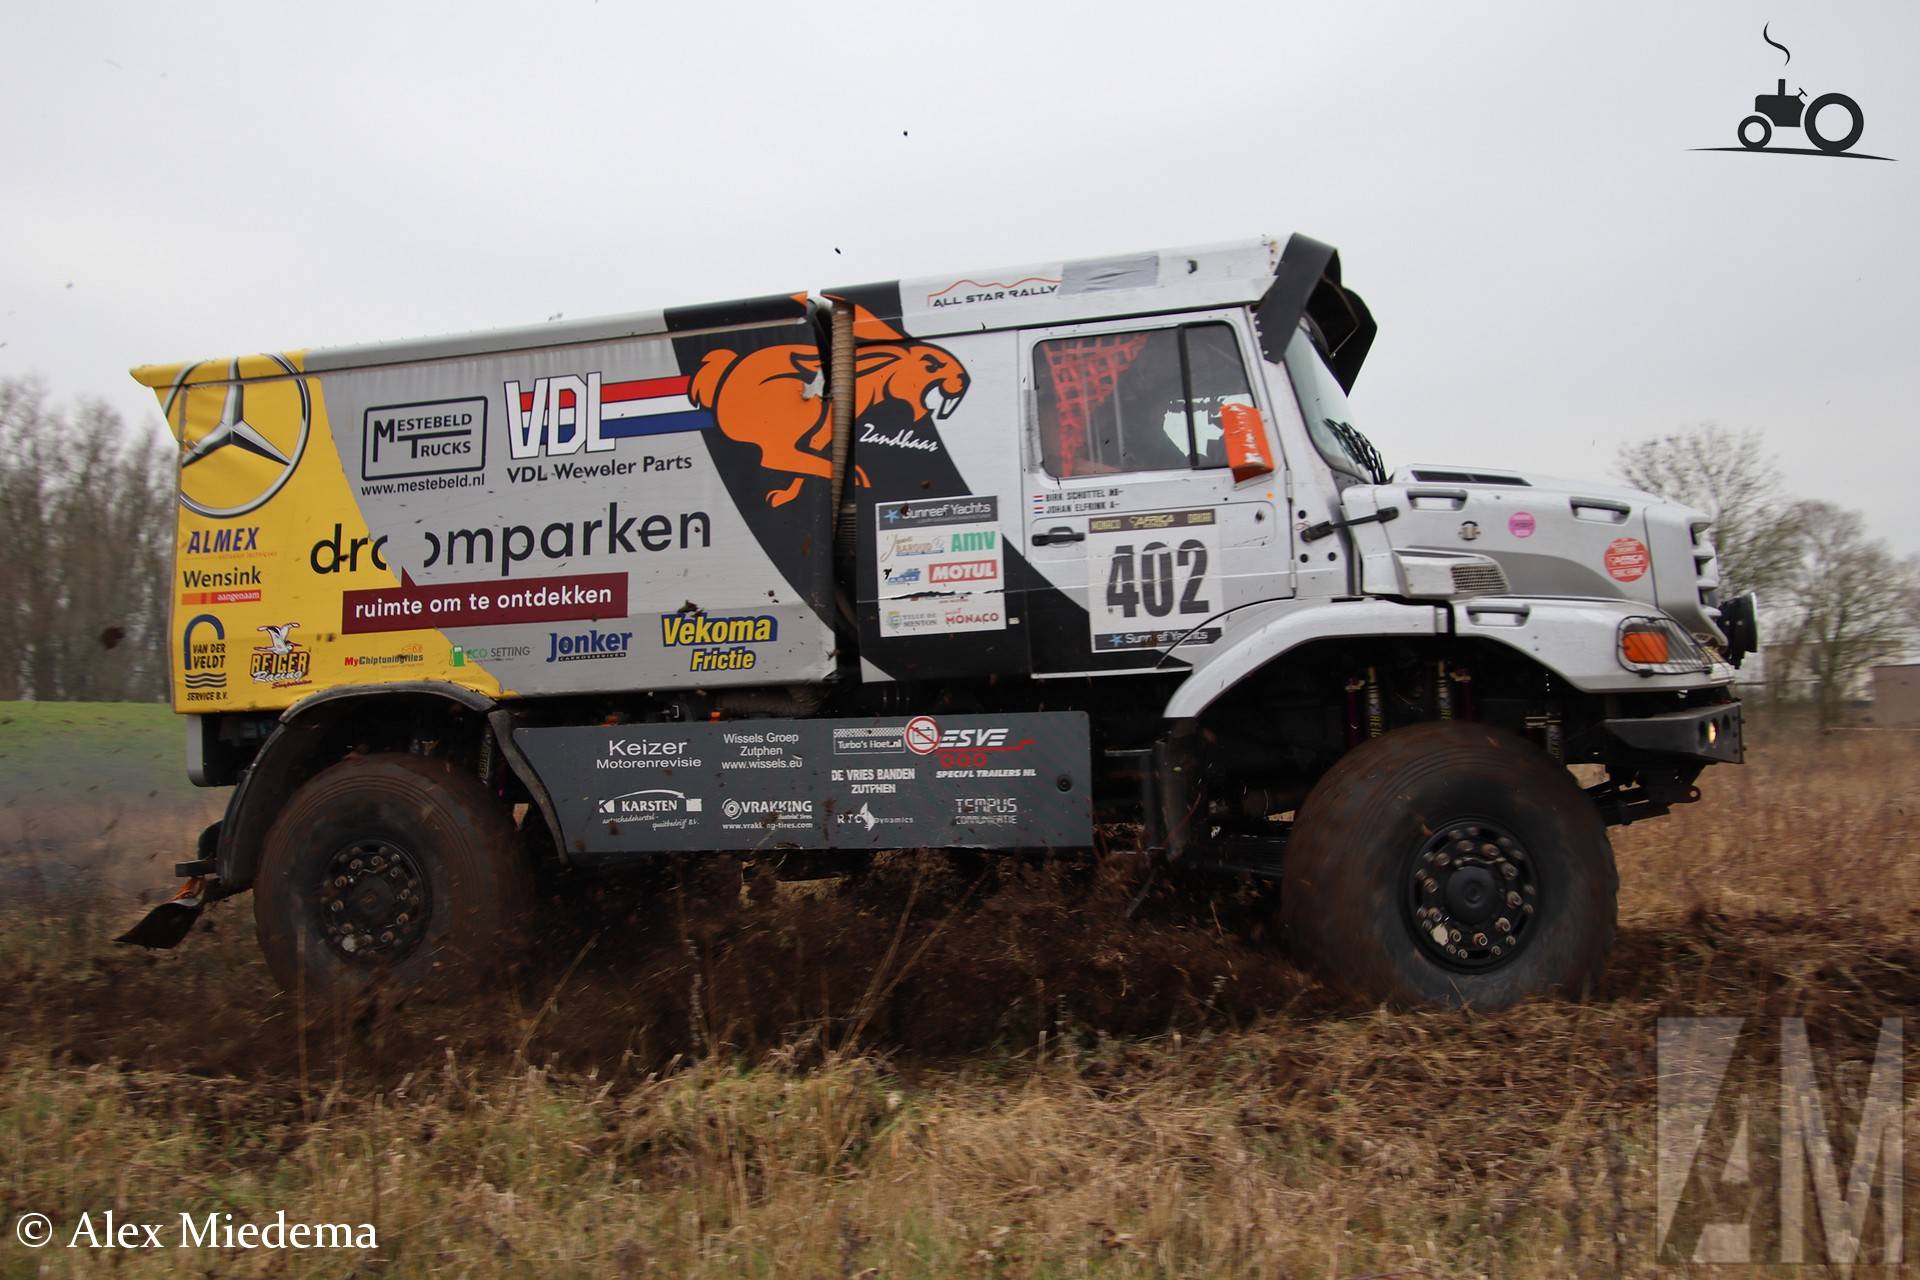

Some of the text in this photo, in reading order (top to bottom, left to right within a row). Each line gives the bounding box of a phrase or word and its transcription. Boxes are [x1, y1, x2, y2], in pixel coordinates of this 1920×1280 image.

[933, 285, 1058, 308] ALL STAR RALLY
[504, 371, 616, 460] VDL
[507, 454, 692, 483] VDL Weweler Parts
[361, 473, 485, 496] www.mestebeld.nl
[950, 503, 991, 515] Yachts
[187, 526, 260, 554] ALMEX
[951, 531, 996, 553] AMV
[183, 565, 262, 588] Wensink
[931, 562, 994, 581] MOTUL
[1106, 539, 1210, 618] 402
[355, 586, 612, 619] ruimte om te ontdekken
[945, 613, 999, 625] MONACO
[661, 613, 777, 647] Vekoma
[1124, 631, 1169, 644] Sunref
[193, 644, 225, 653] VAN DER
[491, 647, 530, 657] SETTING
[546, 629, 633, 662] Jonker
[193, 656, 226, 669] VELDT
[250, 652, 311, 676] REIGER
[690, 647, 756, 672] Frictie
[724, 732, 799, 746] Wissels Groep
[838, 740, 868, 749] Turbo's
[608, 739, 687, 756] Keizer
[740, 746, 783, 758] Zutphen
[597, 757, 702, 769] Motorenrevisie
[721, 757, 803, 770] www.wissels.eu
[831, 768, 915, 781] DE VRIES BANDEN
[976, 769, 1021, 777] TRAILERS
[851, 784, 896, 794] ZUTPHEN
[622, 800, 678, 812] KARSTEN
[742, 801, 812, 813] VRAKKING
[955, 798, 1017, 813] TEMPUS
